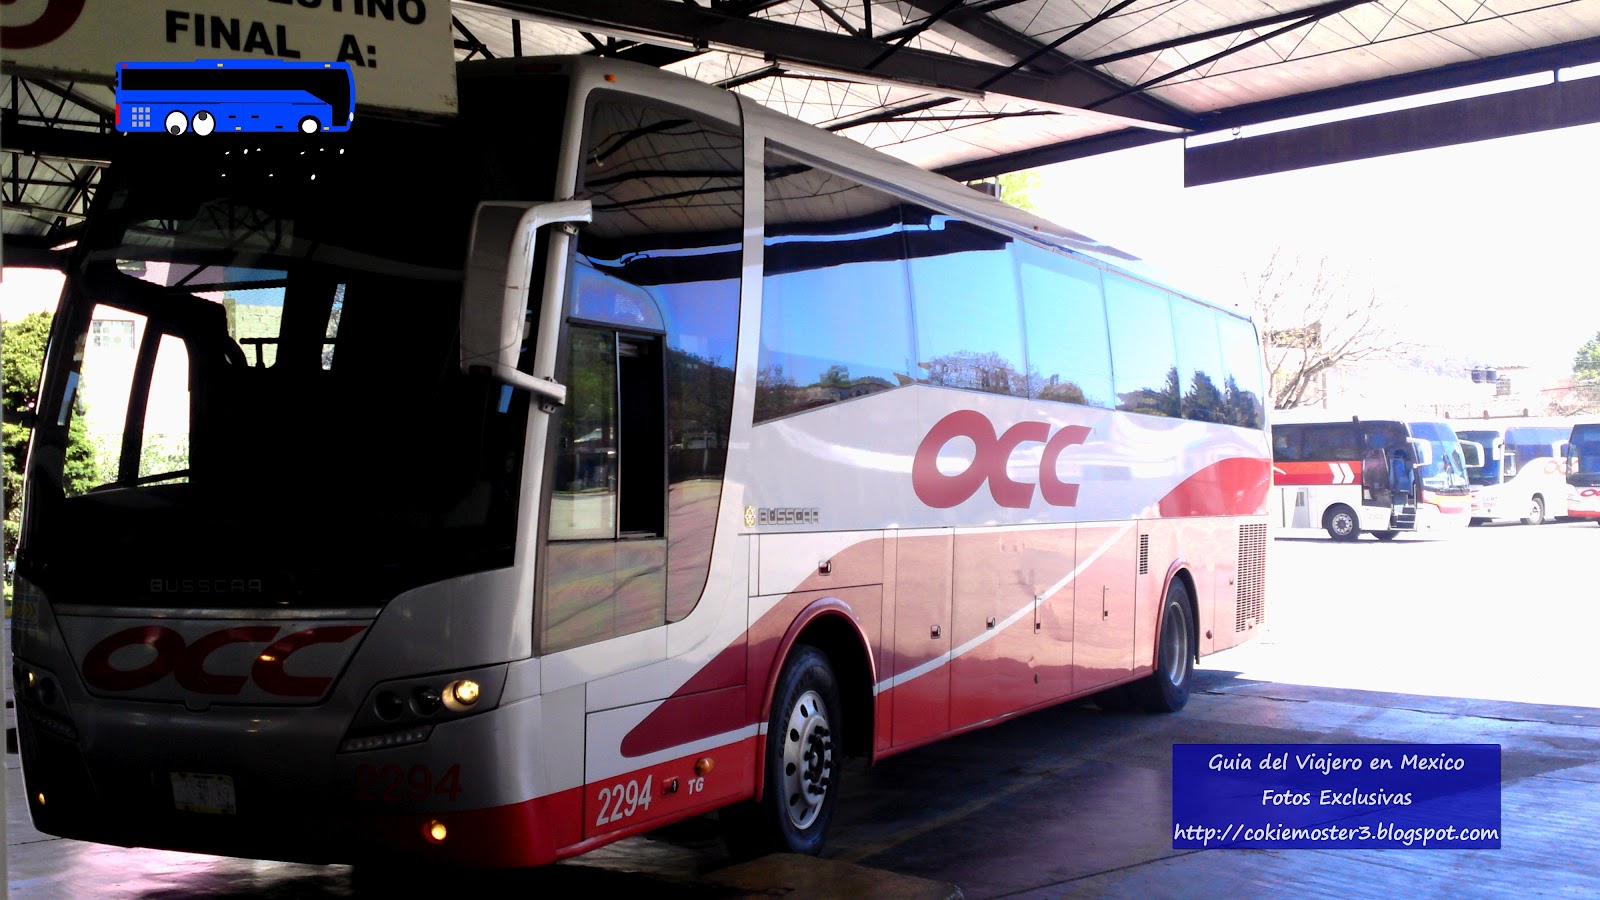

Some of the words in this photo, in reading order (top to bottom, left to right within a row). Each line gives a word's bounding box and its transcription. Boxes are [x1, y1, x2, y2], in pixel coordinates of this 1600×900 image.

[165, 10, 301, 59] FINAL
[336, 34, 377, 69] A:
[912, 409, 1092, 509] OCC
[758, 507, 820, 525] BUSSCAR
[149, 578, 263, 593] BUSSCAR
[82, 625, 371, 697] OCC
[352, 764, 461, 801] 2294
[595, 774, 653, 827] 2294
[687, 777, 705, 795] TG
